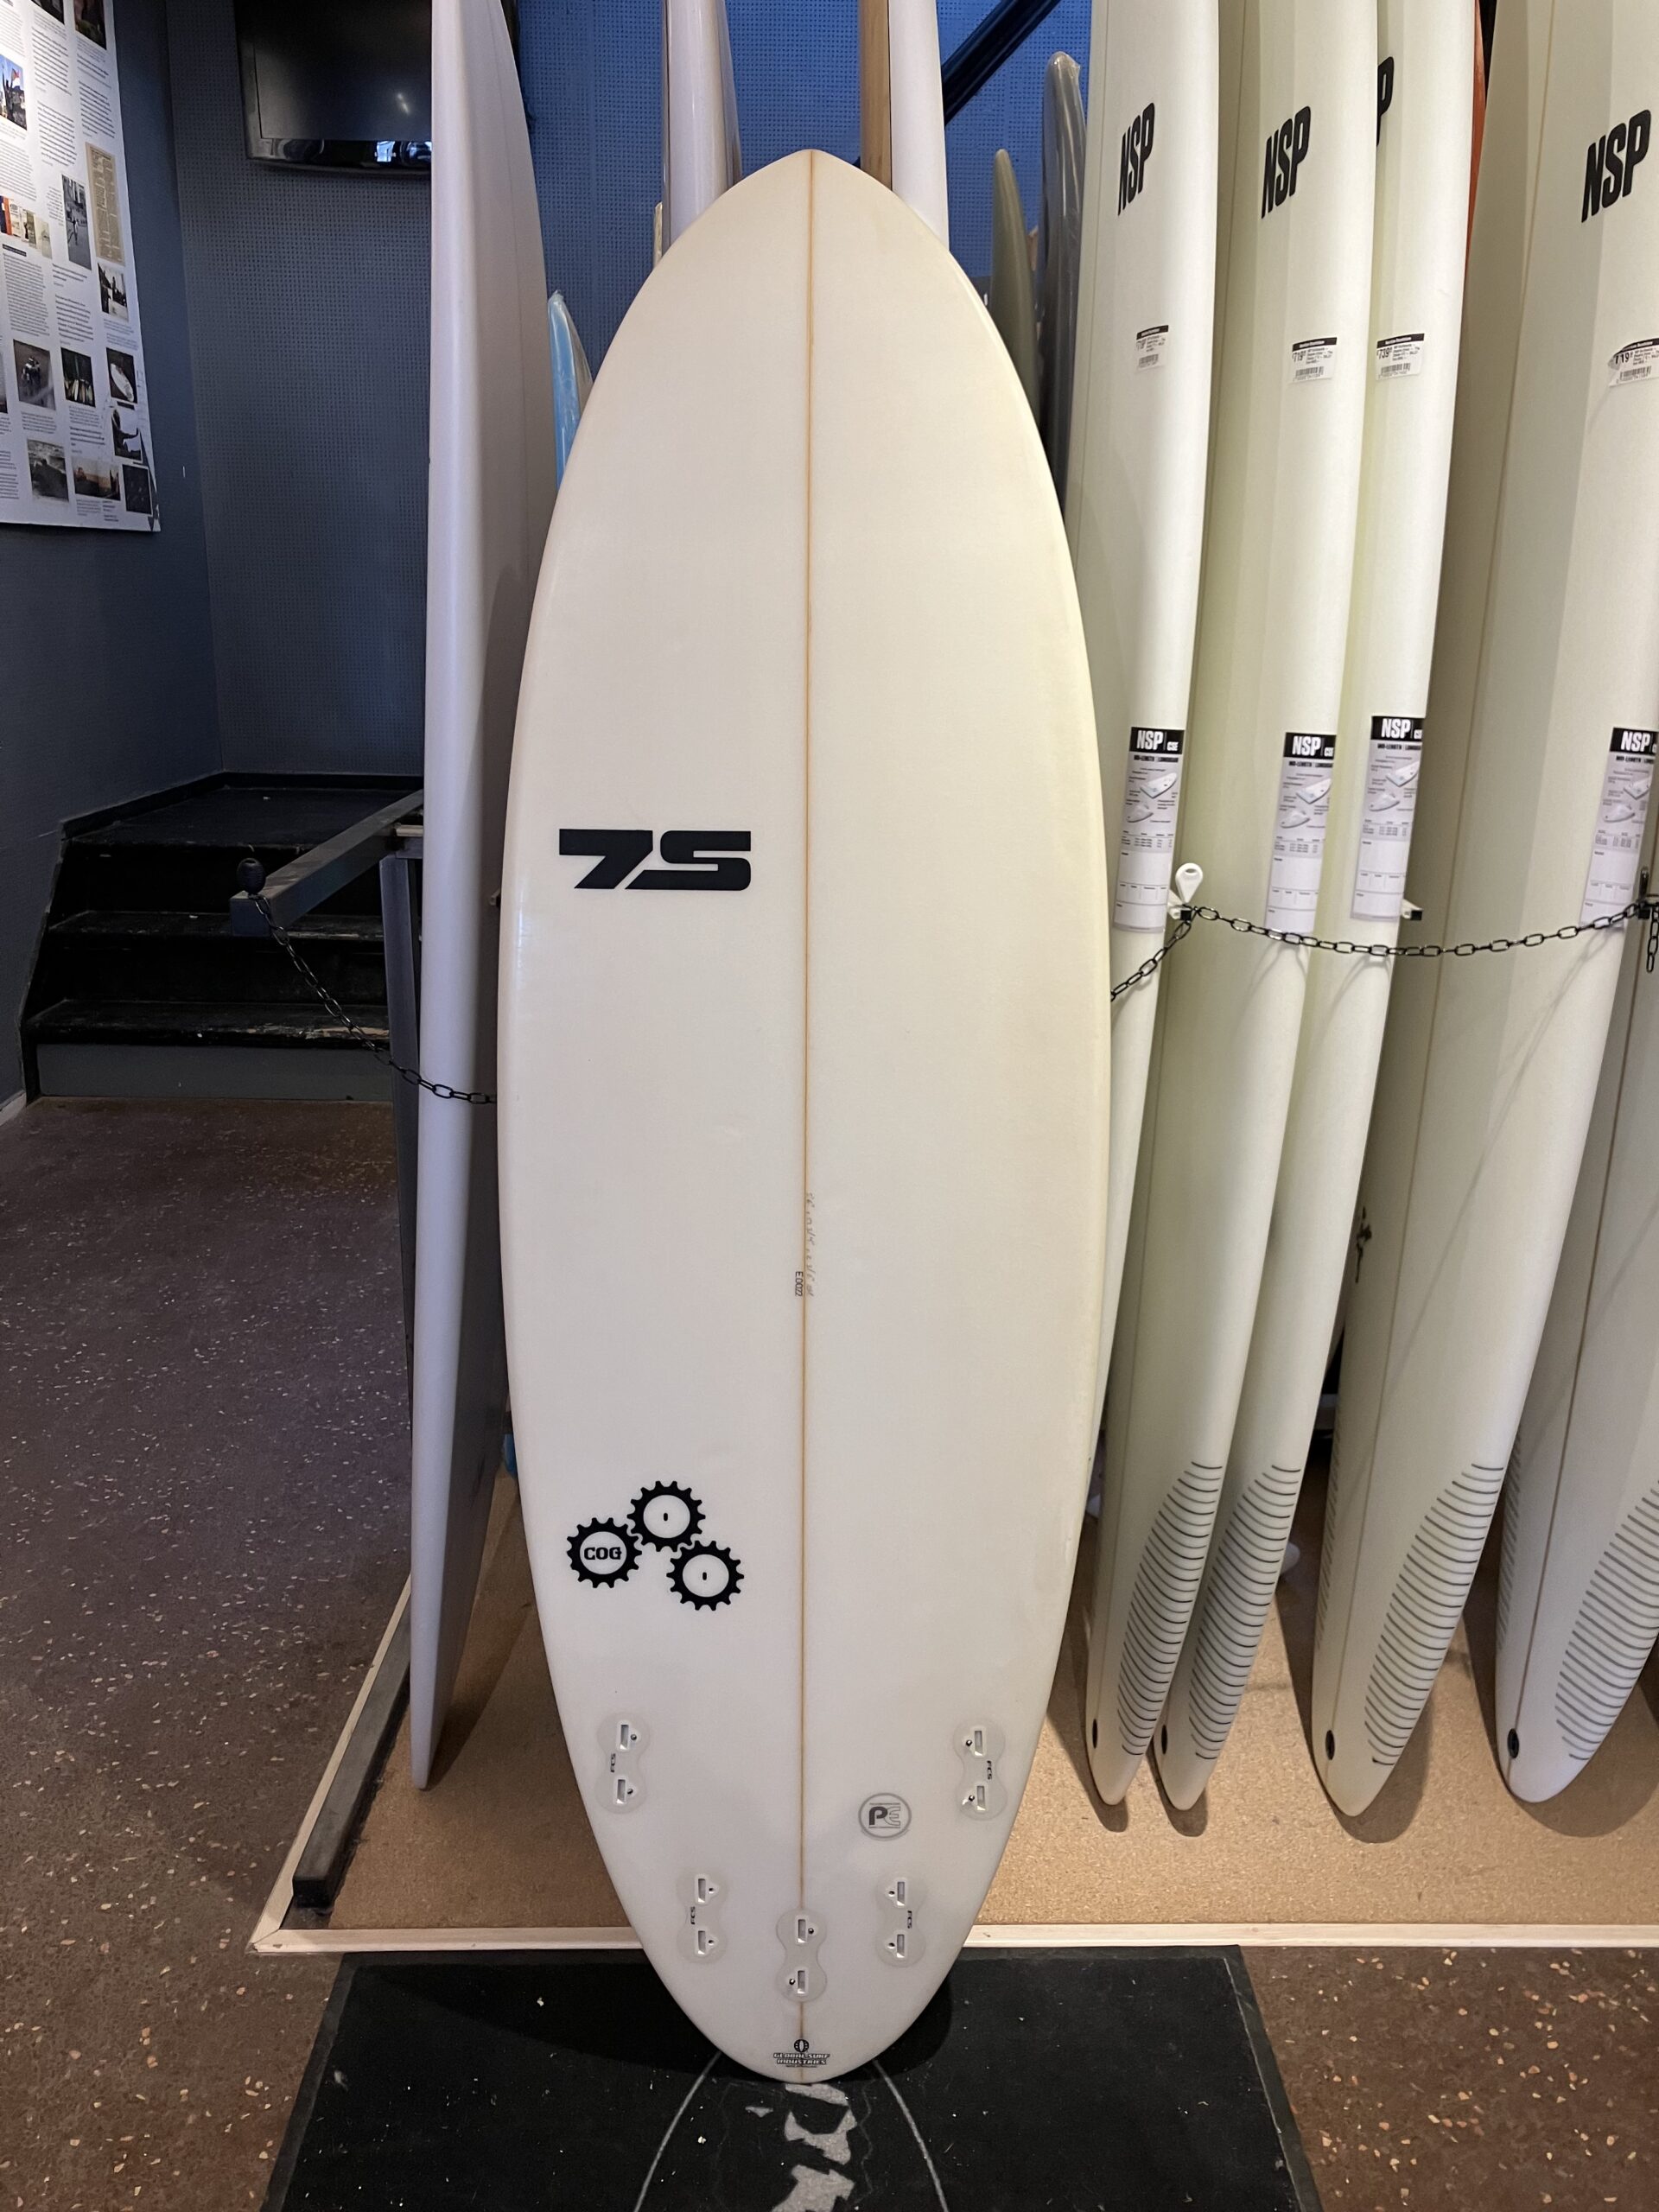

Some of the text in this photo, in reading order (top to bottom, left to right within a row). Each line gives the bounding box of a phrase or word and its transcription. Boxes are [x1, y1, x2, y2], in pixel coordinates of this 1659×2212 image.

[1118, 103, 1154, 216] NSP
[1262, 106, 1311, 219] NSP
[1581, 109, 1651, 223] NSP
[1381, 718, 1411, 739] NSP
[1136, 730, 1164, 751] NSP
[1292, 735, 1321, 756] NSP
[1620, 730, 1650, 752] NSP
[559, 829, 751, 891] 7S
[583, 1547, 622, 1560] COG
